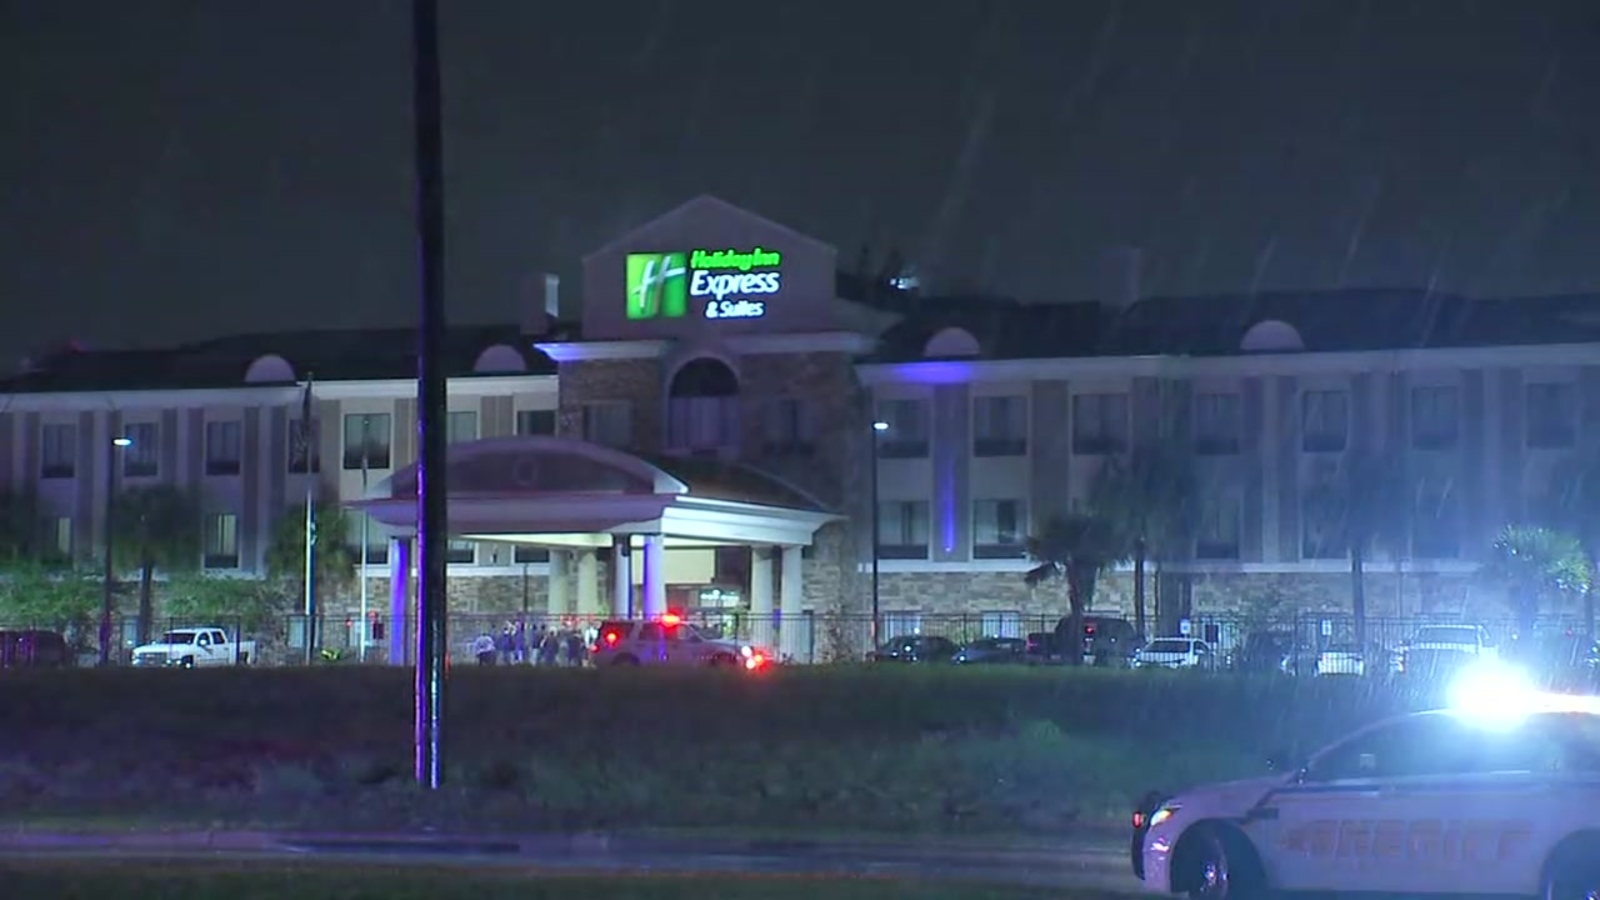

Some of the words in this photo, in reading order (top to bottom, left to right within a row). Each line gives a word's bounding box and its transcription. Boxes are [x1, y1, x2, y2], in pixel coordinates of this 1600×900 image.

[691, 250, 753, 270] Holiday
[752, 248, 780, 266] Inn
[690, 269, 780, 300] Express
[706, 301, 718, 318] &
[719, 300, 764, 317] Suites
